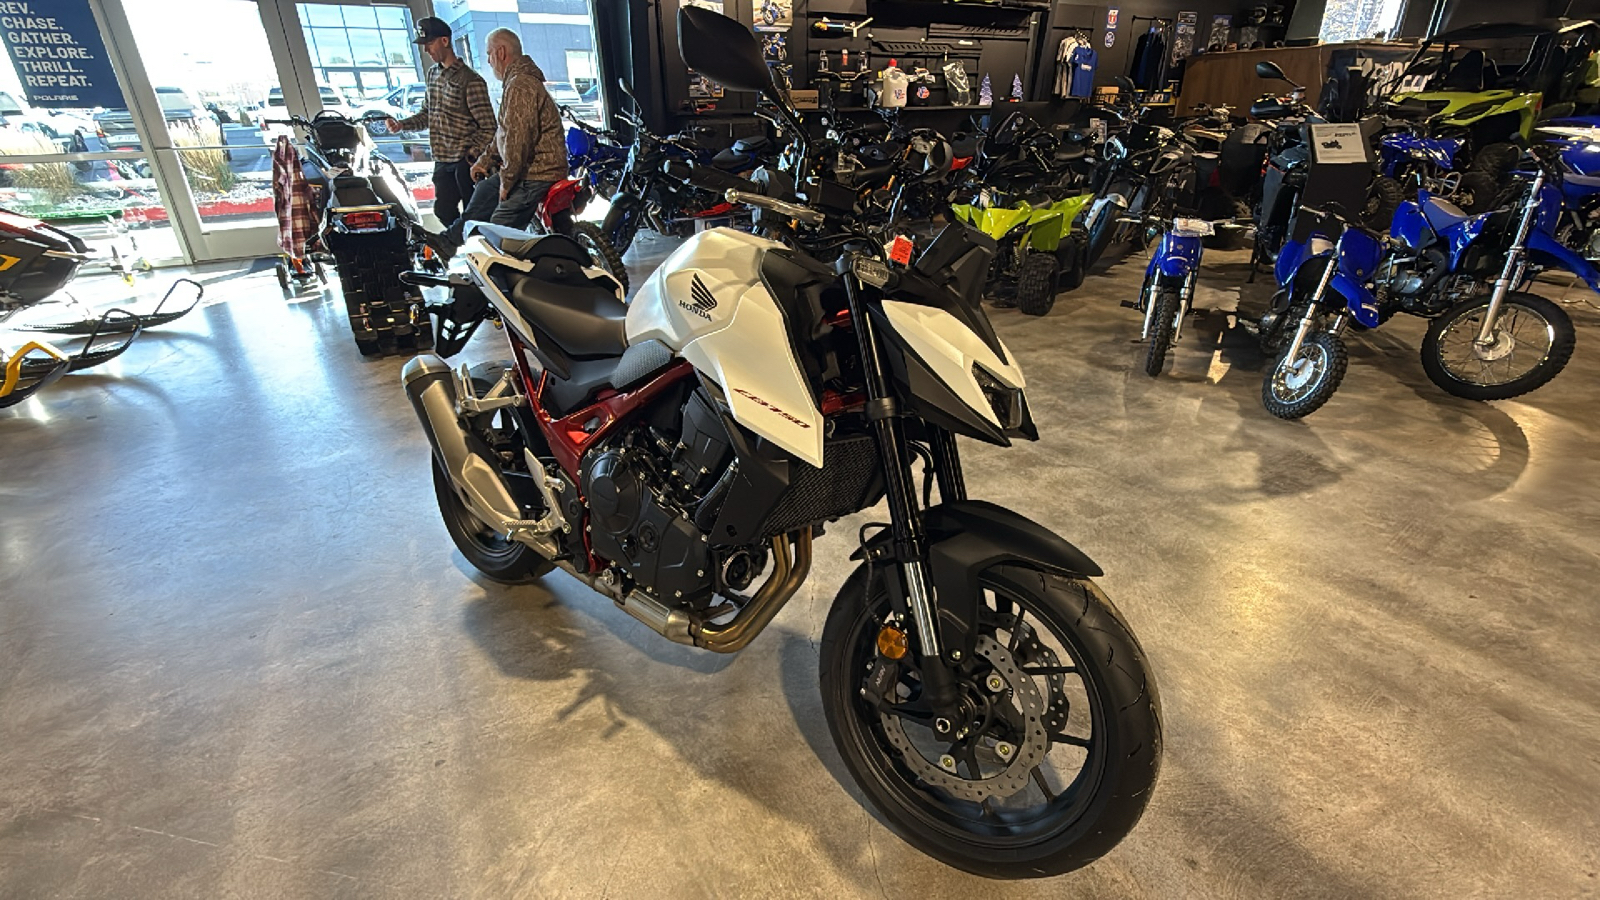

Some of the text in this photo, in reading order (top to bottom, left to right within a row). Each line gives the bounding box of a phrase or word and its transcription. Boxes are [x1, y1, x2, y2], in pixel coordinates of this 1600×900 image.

[0, 2, 35, 15] REV.
[1, 16, 64, 30] CHASE.
[7, 31, 79, 45] GATHER.
[13, 46, 94, 59] EXPLORE.
[18, 61, 84, 73] THRILL.
[25, 75, 93, 87] REPEAT.
[678, 299, 713, 322] HONDA
[733, 387, 811, 429] CB750
